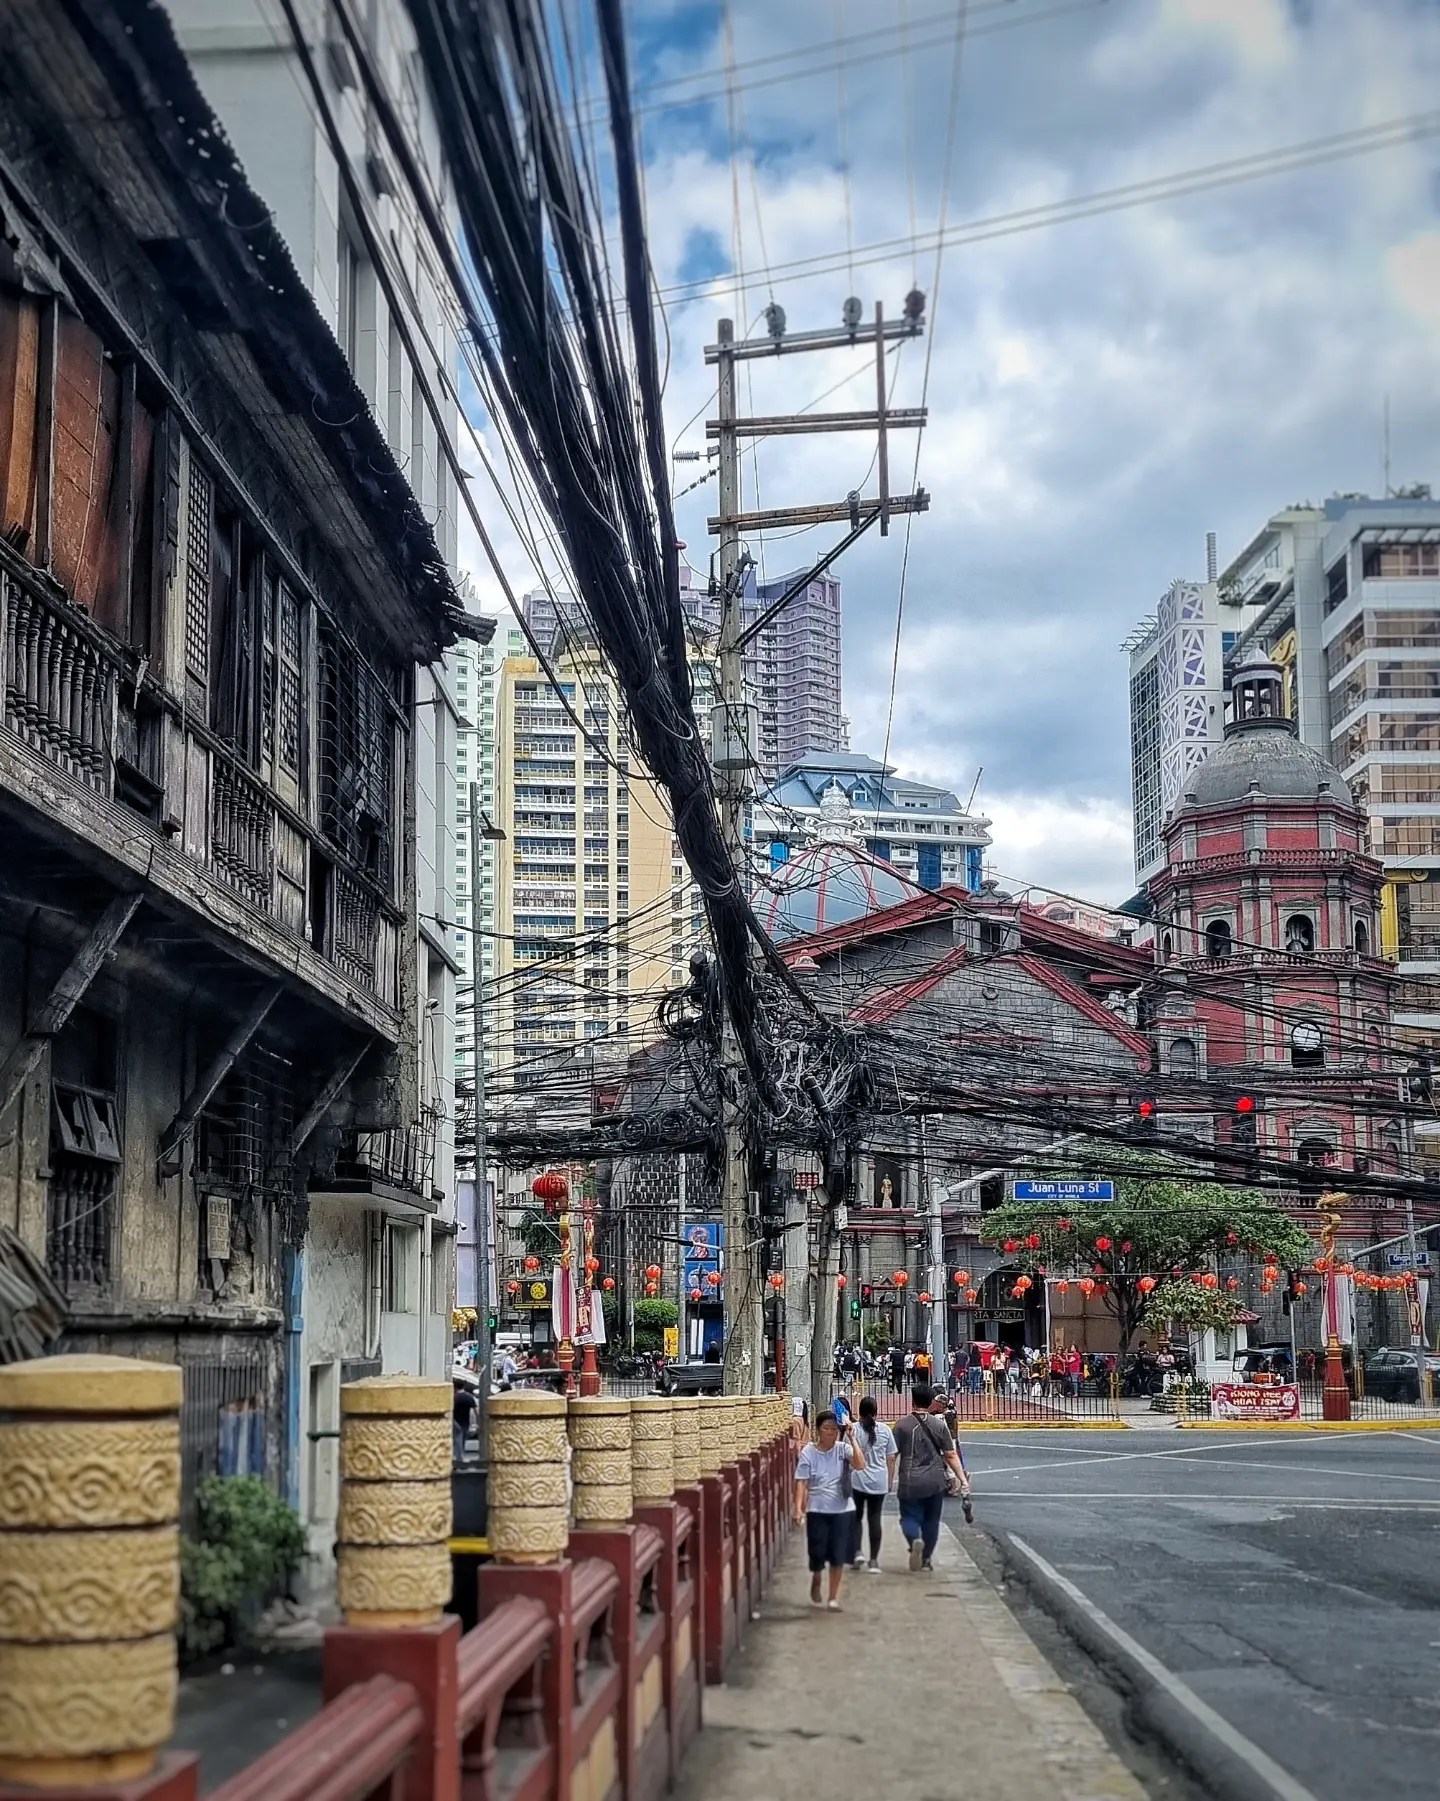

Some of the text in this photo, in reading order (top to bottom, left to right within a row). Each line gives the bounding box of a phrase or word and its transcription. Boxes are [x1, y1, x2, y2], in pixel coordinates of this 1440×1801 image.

[1028, 1183, 1100, 1193] Juan Luna St
